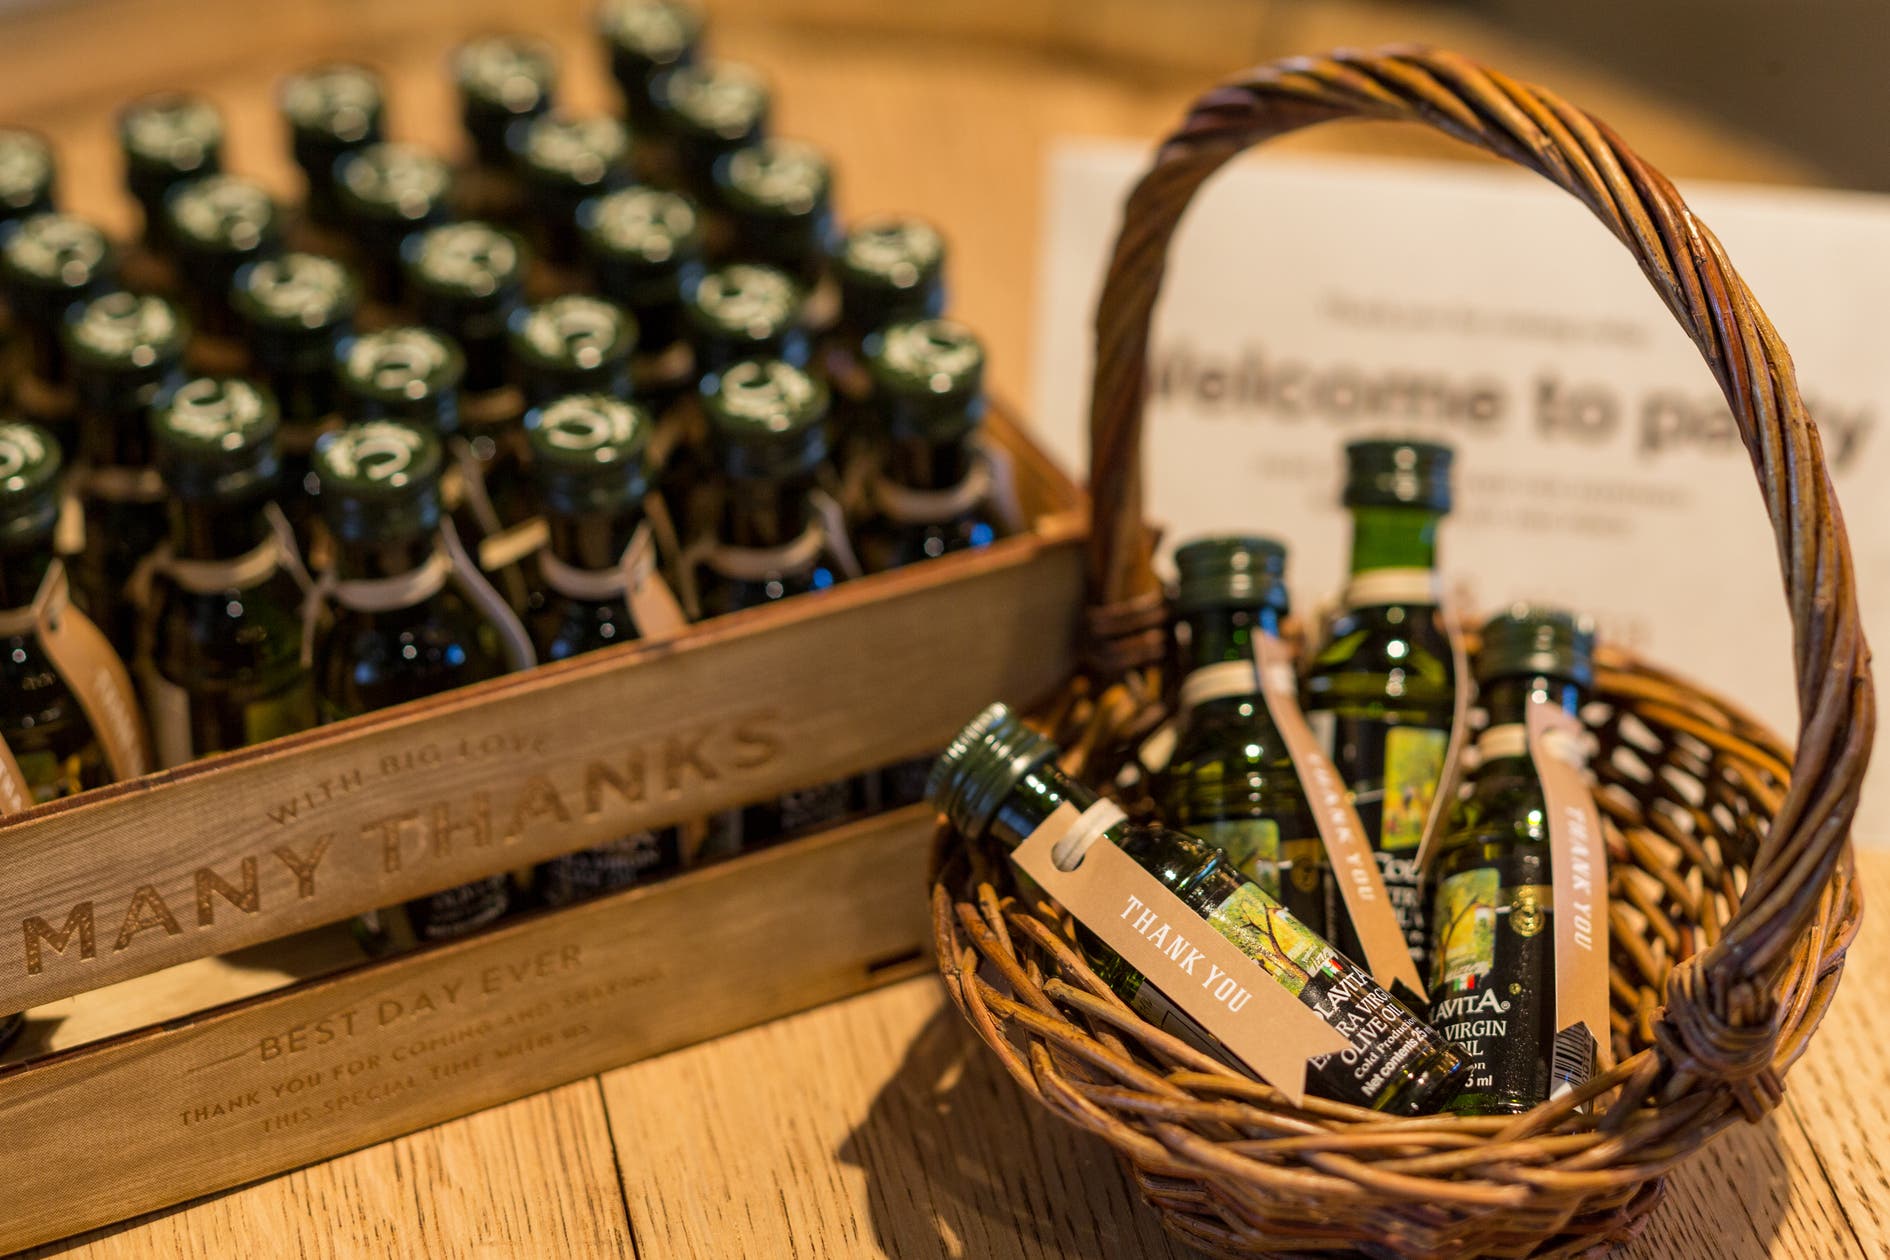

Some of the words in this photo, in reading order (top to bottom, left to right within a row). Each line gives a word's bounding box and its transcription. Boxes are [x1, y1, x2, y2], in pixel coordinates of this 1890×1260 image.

[1534, 362, 1624, 440] to
[267, 768, 363, 825] WITH
[378, 742, 442, 774] BIG
[22, 833, 335, 976] MANY
[360, 707, 780, 873] THANKS
[1307, 752, 1354, 844] THANK
[1345, 852, 1376, 901] YOU
[1565, 806, 1592, 897] THANK
[1120, 894, 1206, 976] THANK
[1202, 963, 1254, 1013] YOU
[1572, 901, 1593, 952] YOU
[258, 1010, 358, 1062] BEST
[377, 979, 464, 1027] DAY
[481, 943, 583, 995] EVER
[1340, 1016, 1388, 1066] OLIVE
[1381, 1002, 1405, 1022] OIL
[1445, 1020, 1507, 1041] VIRGIN
[178, 1090, 261, 1127] THANK
[271, 1072, 323, 1098] YOU
[332, 1055, 381, 1081] FOR
[391, 1020, 493, 1063] COMING
[261, 1106, 313, 1132] THIS
[322, 1075, 416, 1115] SPECIAL
[428, 1053, 484, 1081] TIME
[1353, 1051, 1379, 1079] Cold
[1360, 1074, 1387, 1098] Net
[1379, 1037, 1419, 1078] contents
[1410, 1026, 1428, 1043] 25
[1476, 1074, 1493, 1087] ml
